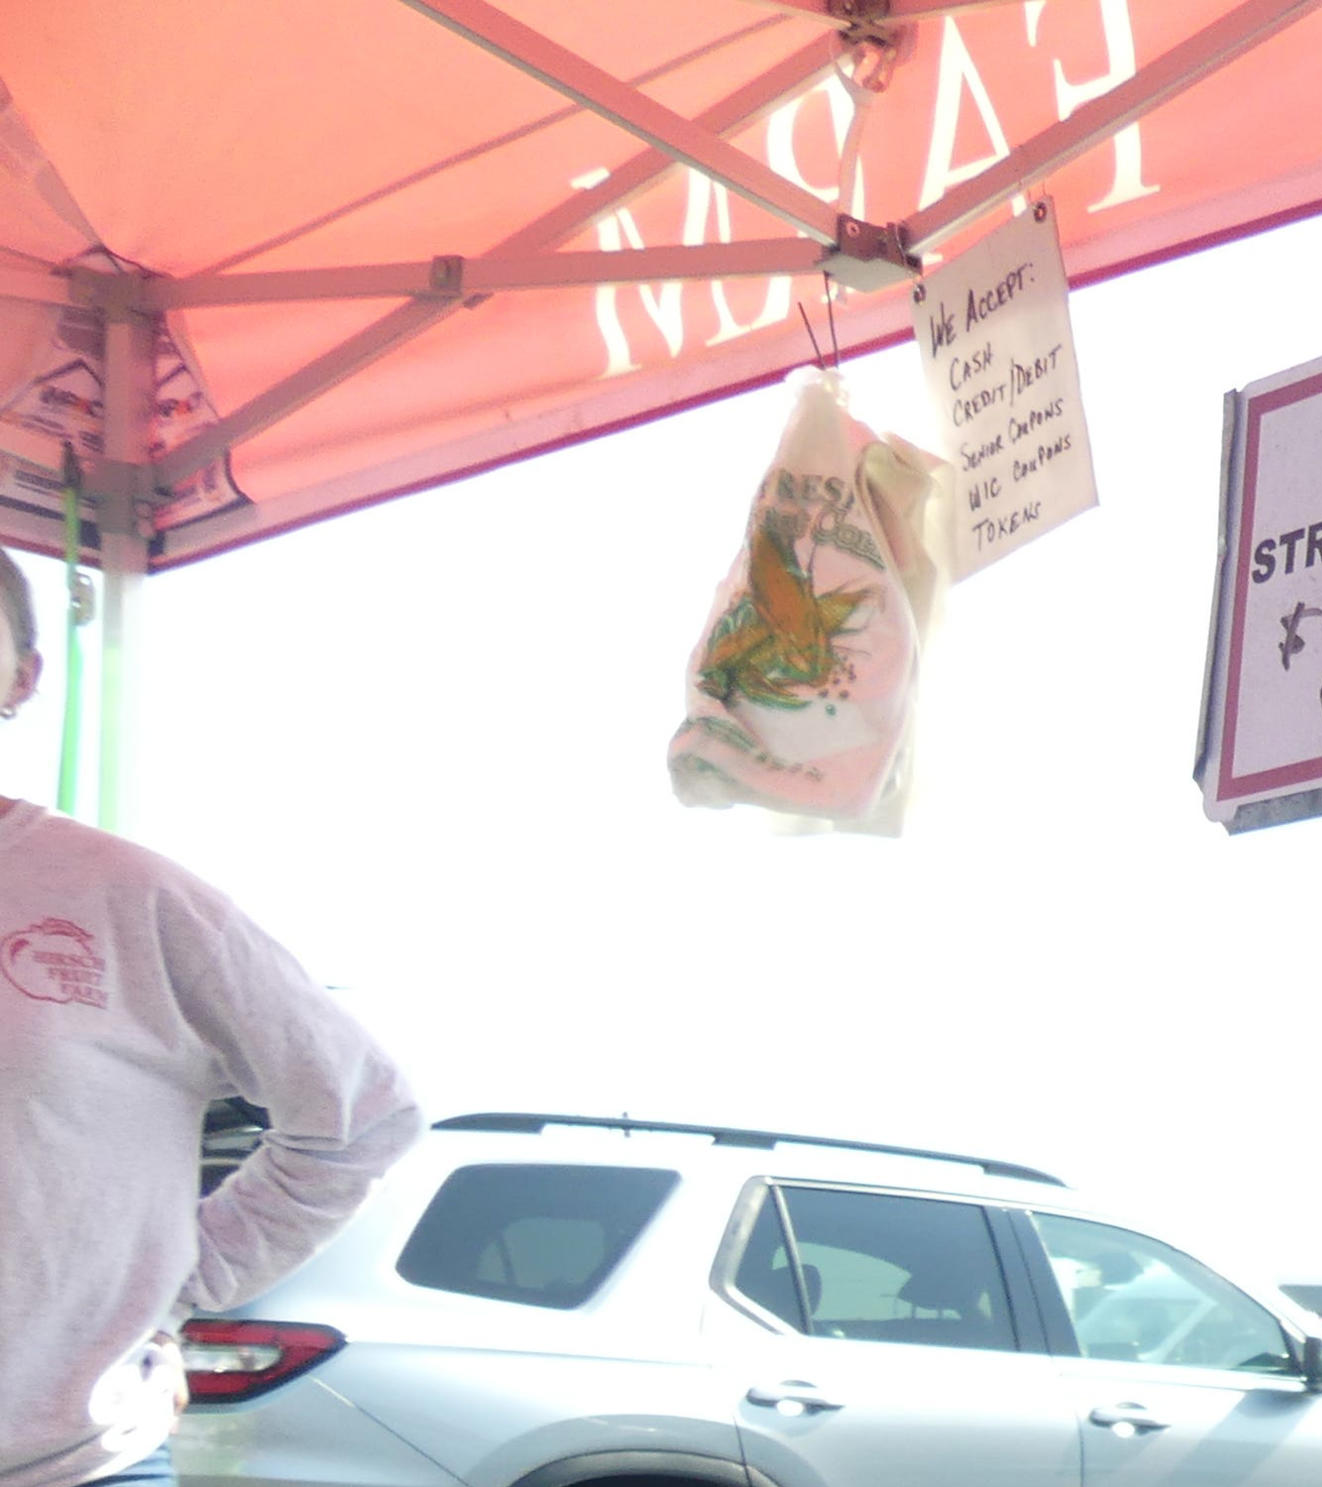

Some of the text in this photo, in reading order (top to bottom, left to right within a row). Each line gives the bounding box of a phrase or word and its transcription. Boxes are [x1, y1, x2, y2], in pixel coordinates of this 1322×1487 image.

[949, 342, 992, 390] CASH
[969, 477, 1001, 512] WIC
[973, 502, 1041, 552] TOKENS
